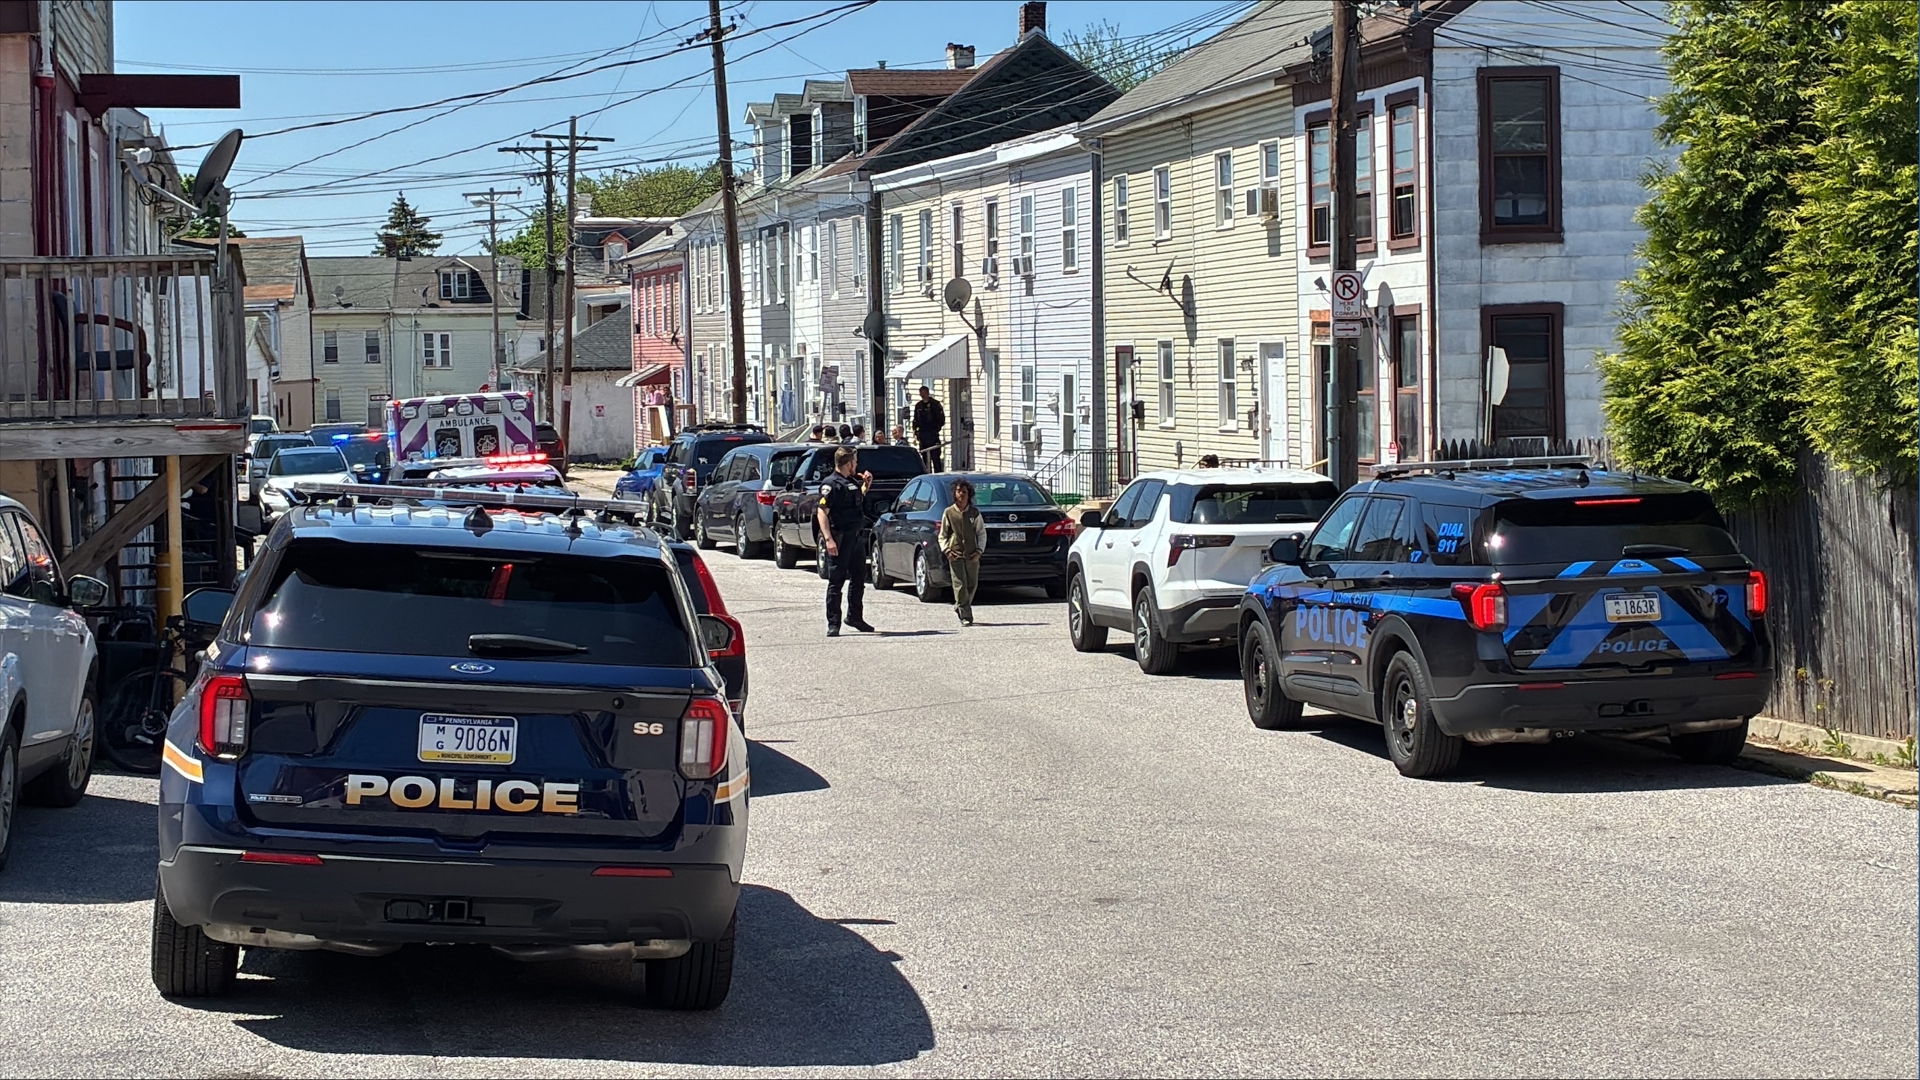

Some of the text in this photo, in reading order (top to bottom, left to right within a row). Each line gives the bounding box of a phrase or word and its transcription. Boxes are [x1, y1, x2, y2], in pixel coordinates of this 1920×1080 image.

[439, 416, 491, 427] AMBULANCE
[1438, 522, 1465, 537] DIAL
[1437, 539, 1458, 553] 911
[1410, 550, 1422, 562] 17
[1353, 592, 1373, 606] CITY
[1712, 594, 1728, 604] 17
[1624, 599, 1656, 615] 1863R
[1295, 603, 1370, 649] POLICE
[1598, 638, 1671, 654] POLICE
[460, 663, 485, 671] Ford
[445, 717, 493, 725] PENNSYLVANIA
[633, 721, 664, 735] S6
[436, 726, 446, 735] M
[436, 741, 445, 750] G
[455, 726, 511, 752] 9086N
[345, 773, 580, 814] POLICE
